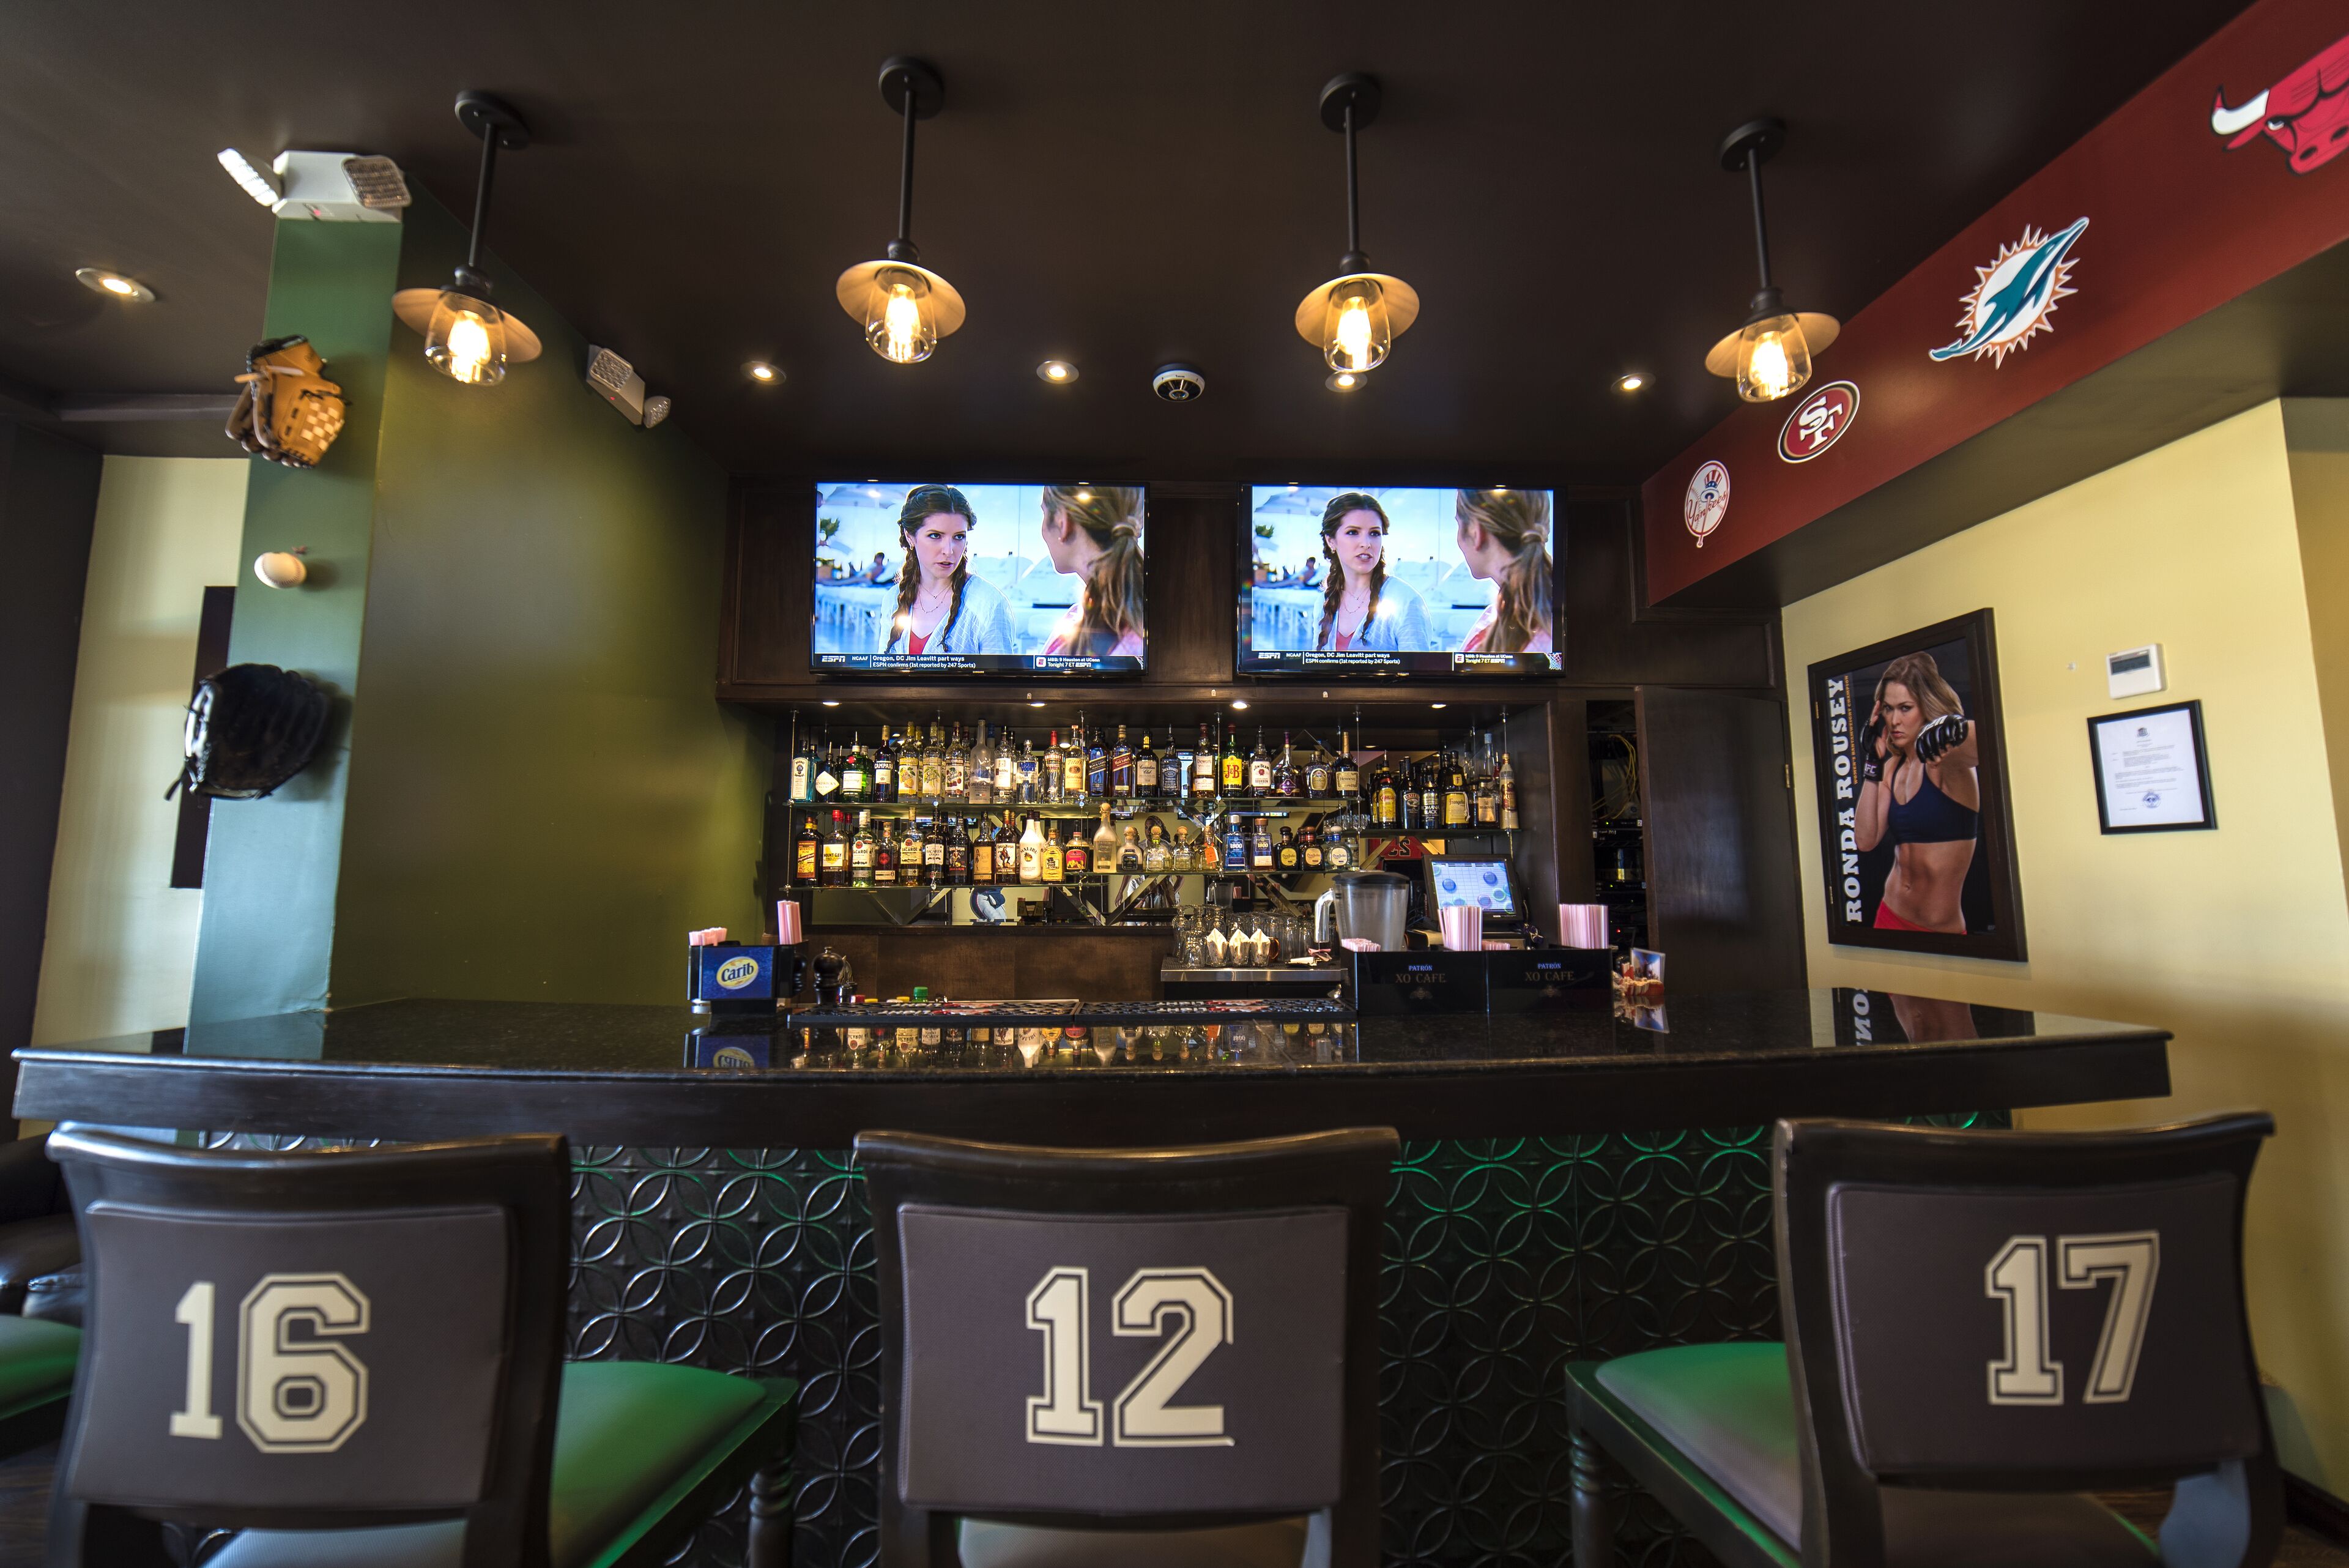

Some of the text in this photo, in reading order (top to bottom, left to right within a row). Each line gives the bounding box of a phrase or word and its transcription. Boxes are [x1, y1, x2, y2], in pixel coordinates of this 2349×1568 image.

[1798, 396, 1842, 450] SF
[1687, 491, 1728, 528] Yankees
[1225, 765, 1240, 778] J&B
[1828, 679, 1863, 922] RONDA ROUSEY
[721, 962, 754, 982] Carib
[1395, 974, 1411, 983] XO
[1525, 972, 1540, 981] XO
[1984, 1229, 2160, 1405] 17
[169, 1271, 371, 1454] 16
[1025, 1265, 1235, 1447] 12
